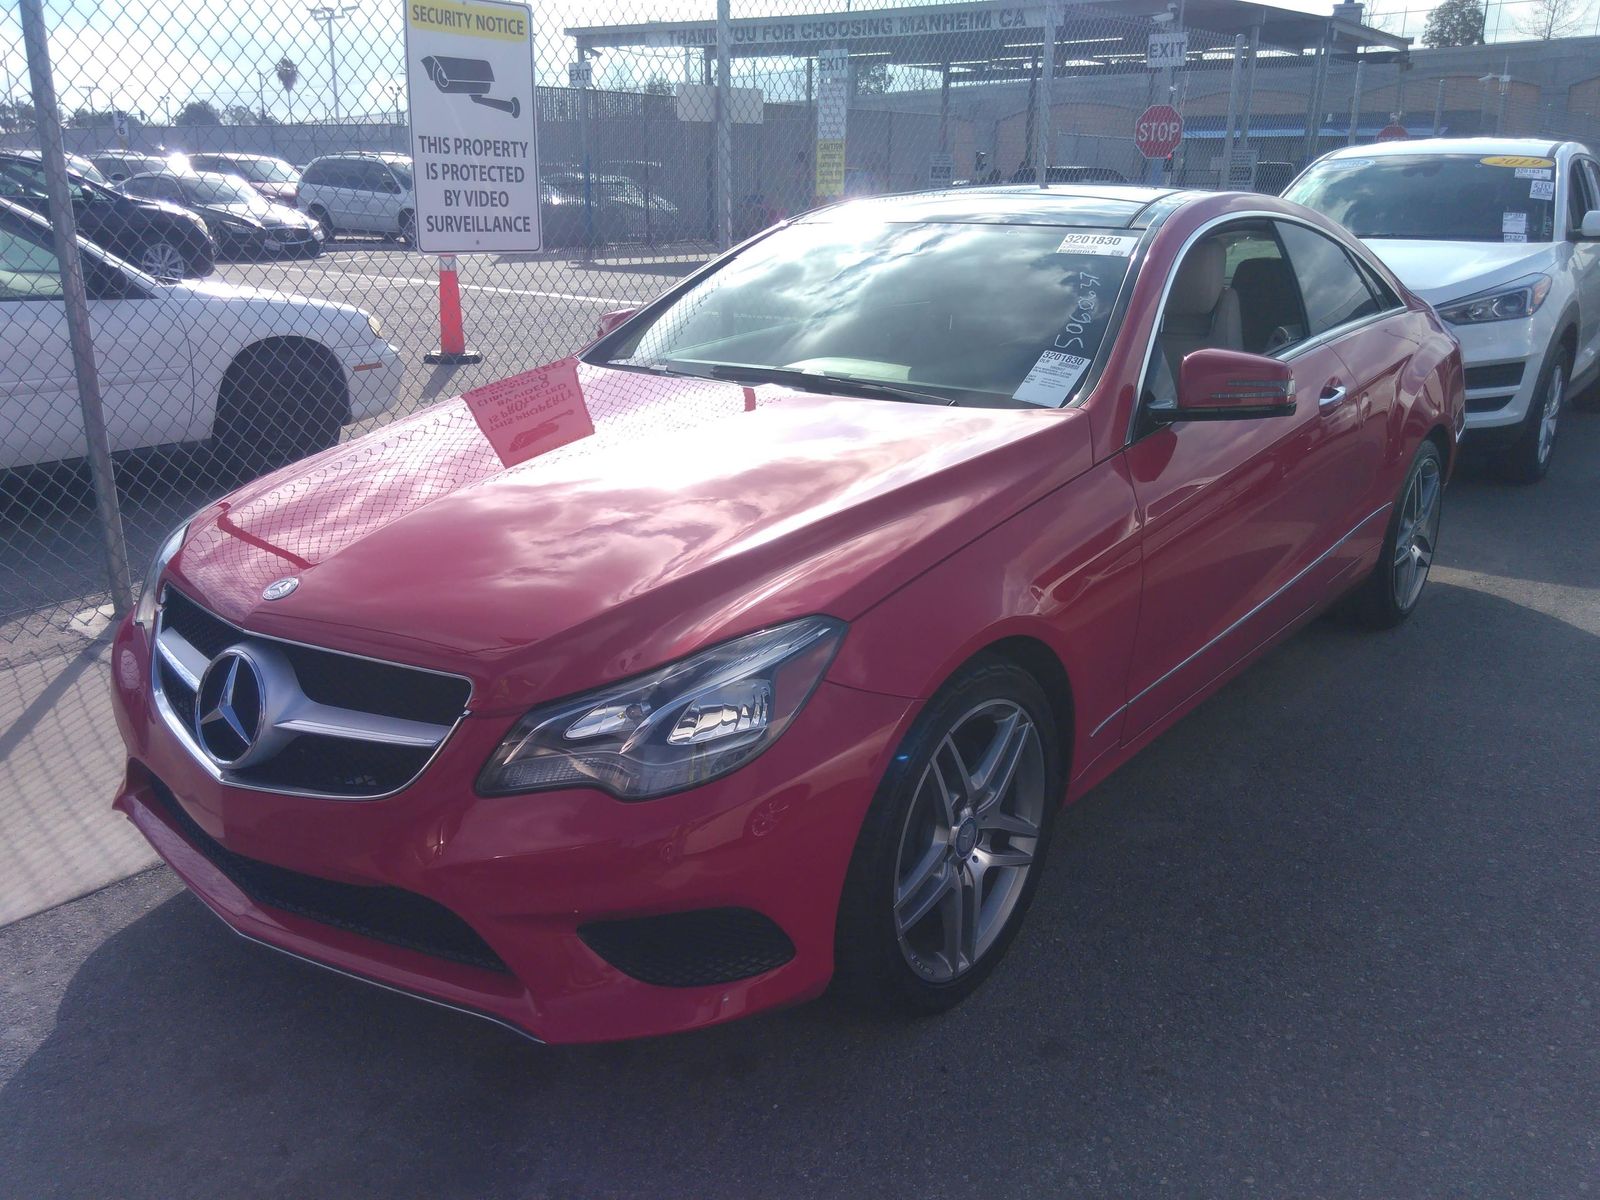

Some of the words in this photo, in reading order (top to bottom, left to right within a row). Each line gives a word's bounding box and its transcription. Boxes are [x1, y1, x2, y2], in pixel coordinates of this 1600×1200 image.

[412, 5, 473, 29] SECURITY
[476, 15, 525, 35] NOTICE
[762, 24, 796, 42] FOR
[800, 17, 893, 40] CHOOSING
[901, 9, 992, 34] MANHEIM
[999, 8, 1027, 28] CA
[1149, 41, 1185, 59] EXIT
[820, 57, 847, 72] EXIT
[570, 69, 591, 81] EXIT
[1139, 122, 1180, 142] STOP
[418, 136, 450, 155] THIS
[455, 138, 529, 159] PROPERTY
[426, 163, 438, 180] IS
[442, 164, 525, 183] PROTECTED
[444, 190, 462, 208] BY
[464, 190, 510, 208] VIDEO
[426, 215, 531, 233] SURVEILLANCE
[1065, 234, 1122, 246] 3201830
[1042, 350, 1085, 366] 3201830
